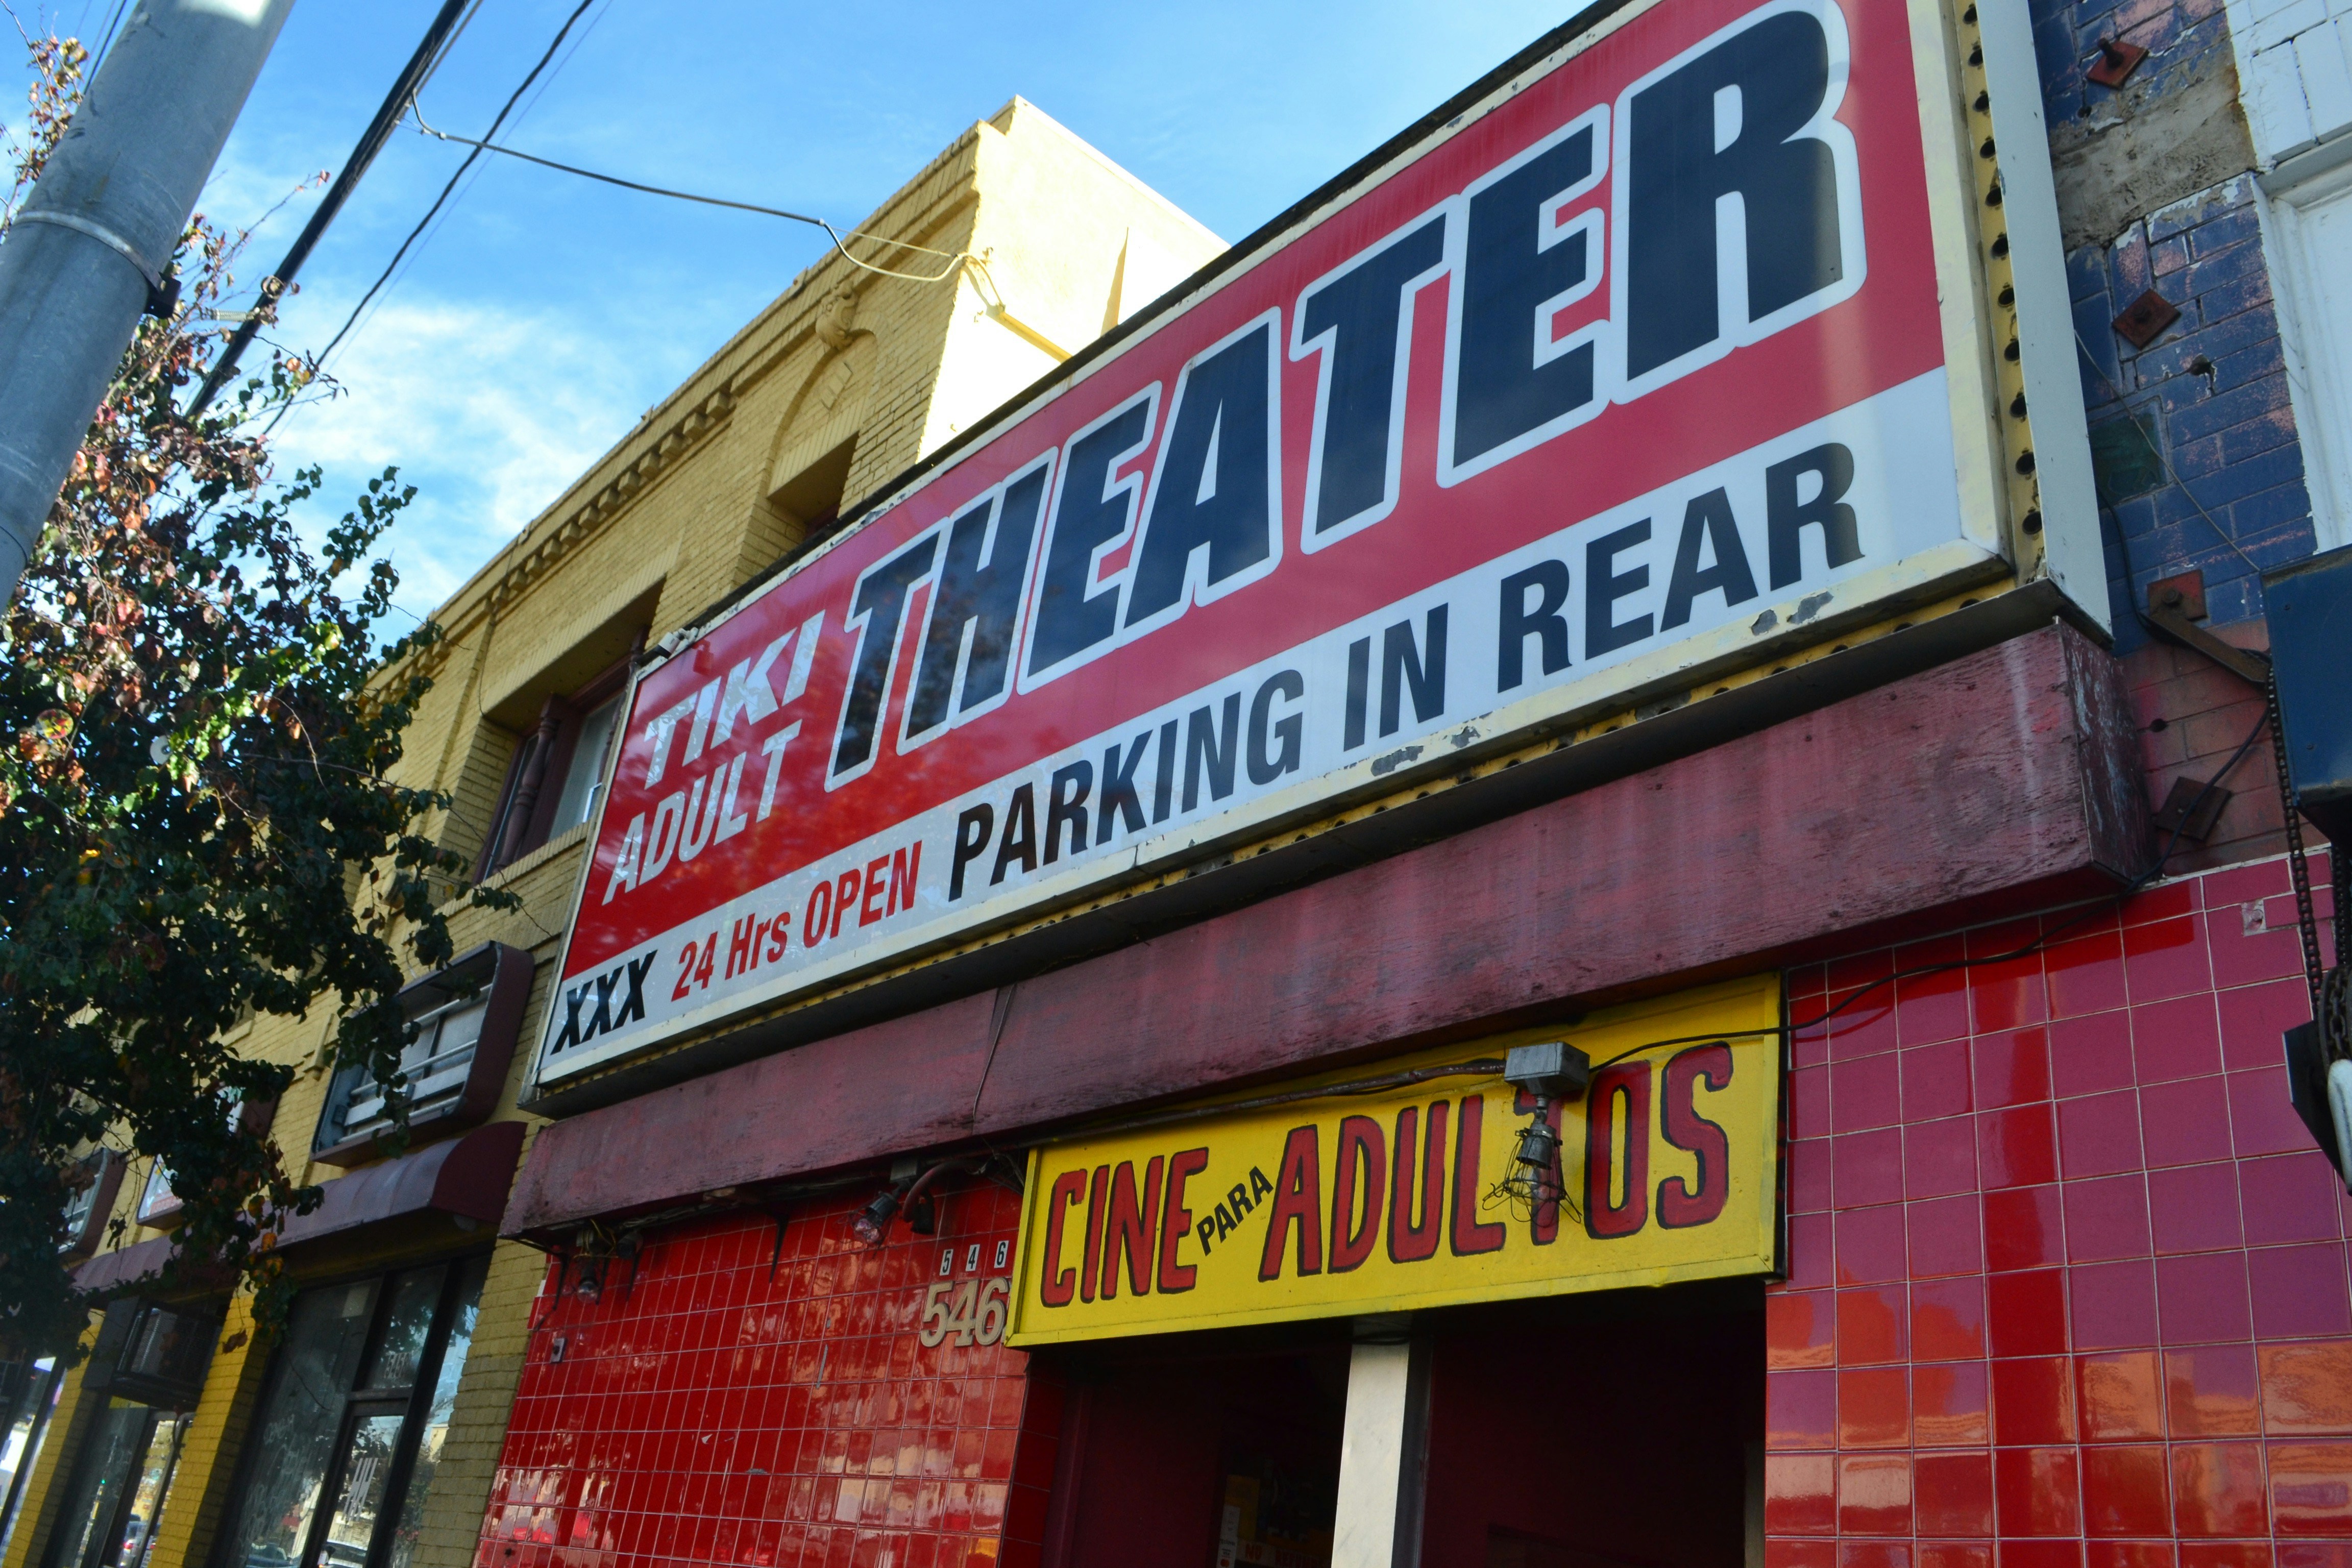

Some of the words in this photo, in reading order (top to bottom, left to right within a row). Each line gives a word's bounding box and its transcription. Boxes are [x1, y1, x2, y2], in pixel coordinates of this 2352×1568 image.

[824, 0, 1867, 792] THEATER
[644, 609, 825, 790] TIKI
[948, 669, 1304, 902] PARKING
[1343, 602, 1449, 752] IN
[1497, 442, 1866, 694] REAR
[602, 719, 803, 906] ADULT
[550, 949, 658, 1056] XXX
[671, 931, 719, 1002] 24
[724, 913, 791, 981] Hrs
[802, 840, 923, 948] OPEN
[1041, 1147, 1209, 1307] CINE
[1196, 1166, 1275, 1256] PARA
[1259, 1042, 1733, 1282] ADULTOS
